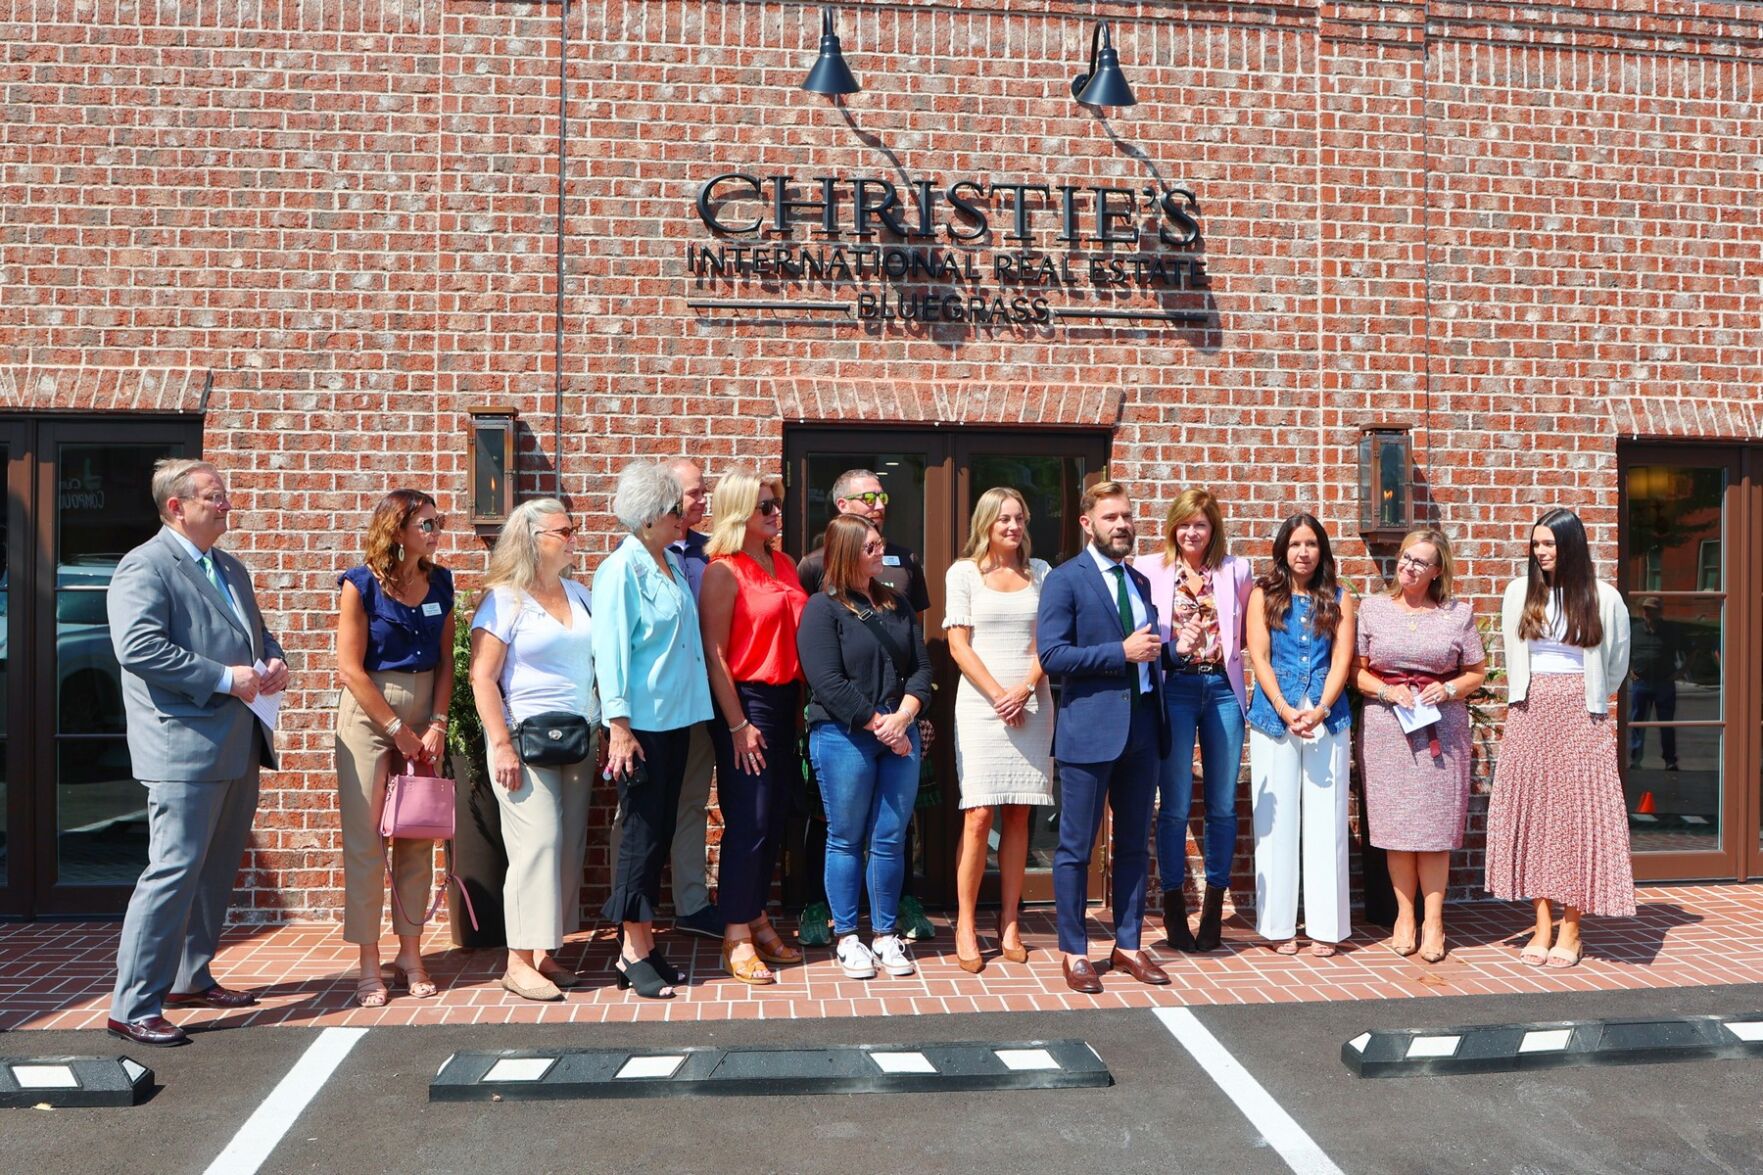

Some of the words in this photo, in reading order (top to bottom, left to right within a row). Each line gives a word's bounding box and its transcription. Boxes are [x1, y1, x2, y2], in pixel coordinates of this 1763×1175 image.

[696, 173, 1198, 245] CHRISTIE'S
[687, 246, 982, 280] INTERNATIONAL
[994, 255, 1078, 282] REAL
[1089, 257, 1207, 286] ESTATE
[857, 292, 1048, 323] BLUEGRASS
